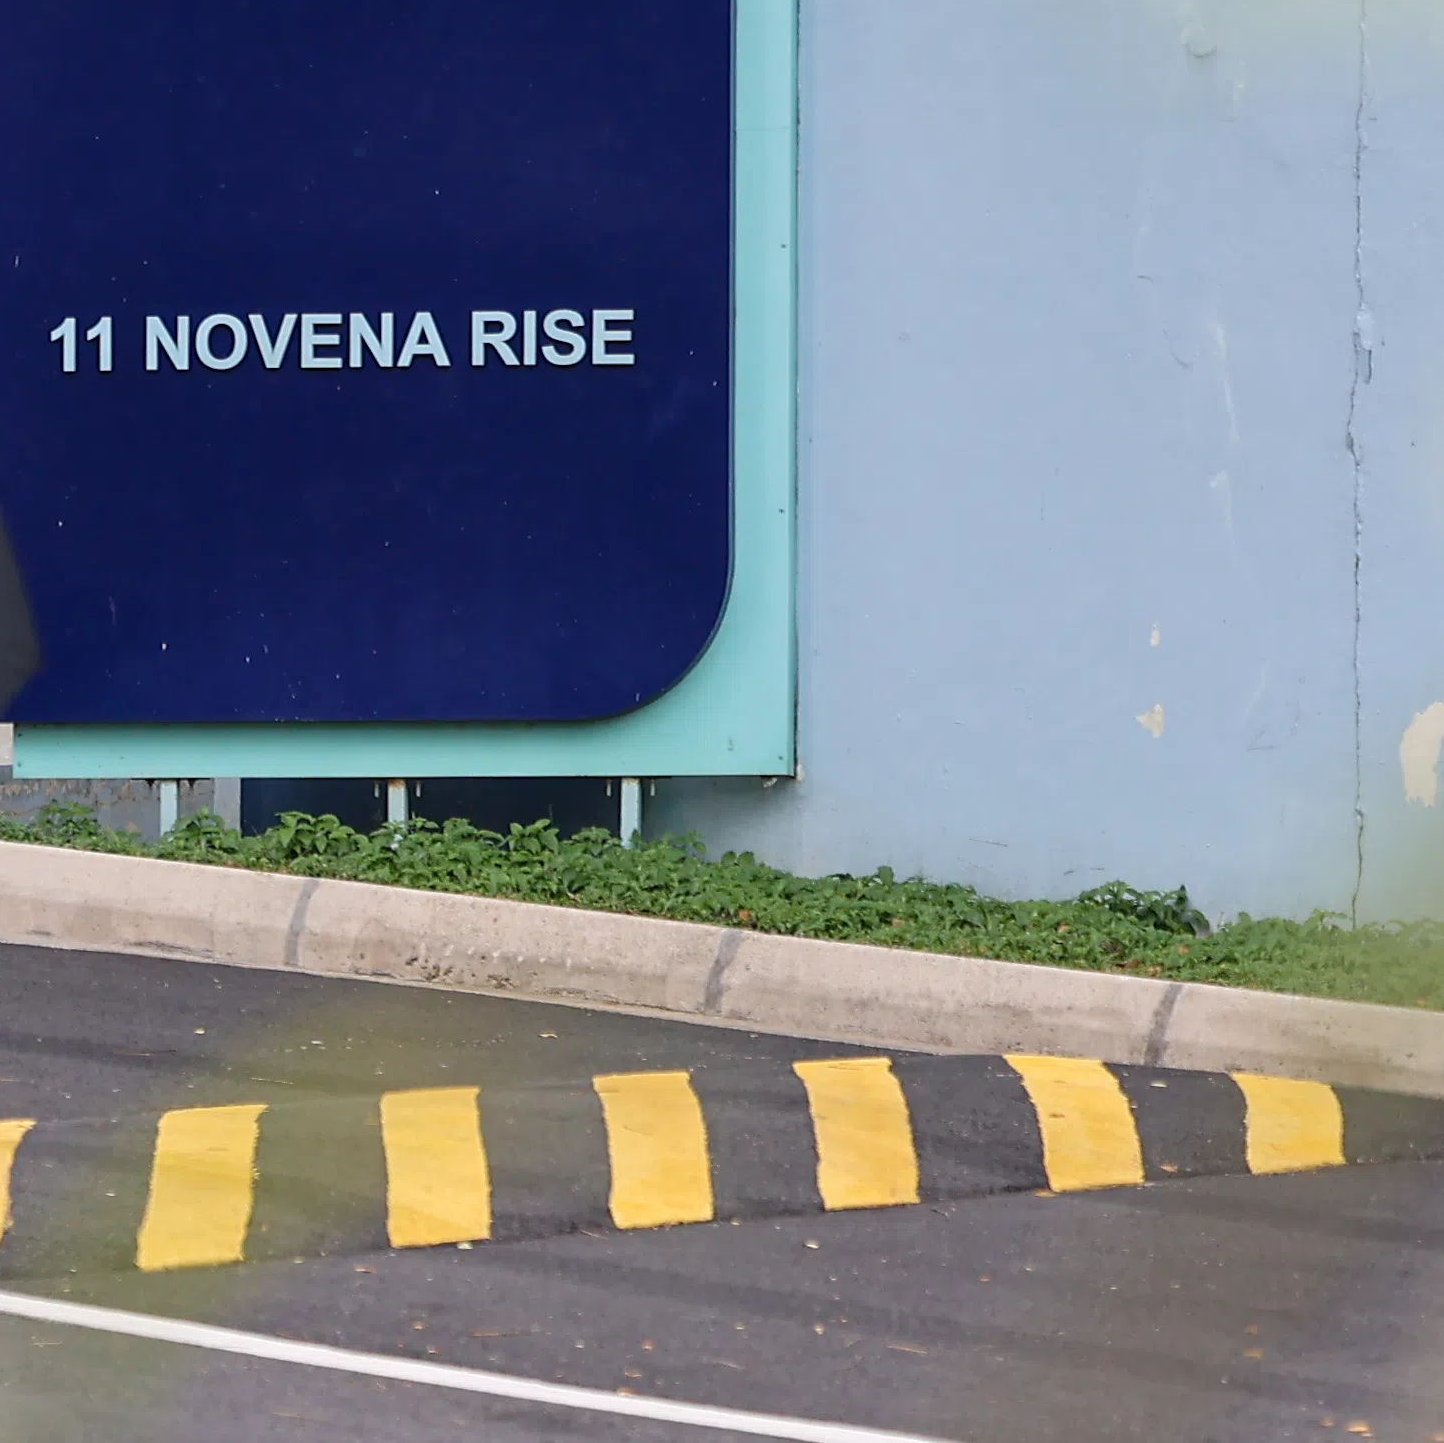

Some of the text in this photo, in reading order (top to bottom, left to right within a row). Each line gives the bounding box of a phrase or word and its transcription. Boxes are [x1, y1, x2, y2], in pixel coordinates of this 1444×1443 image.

[49, 308, 636, 372] 11 NOVENA RISE
